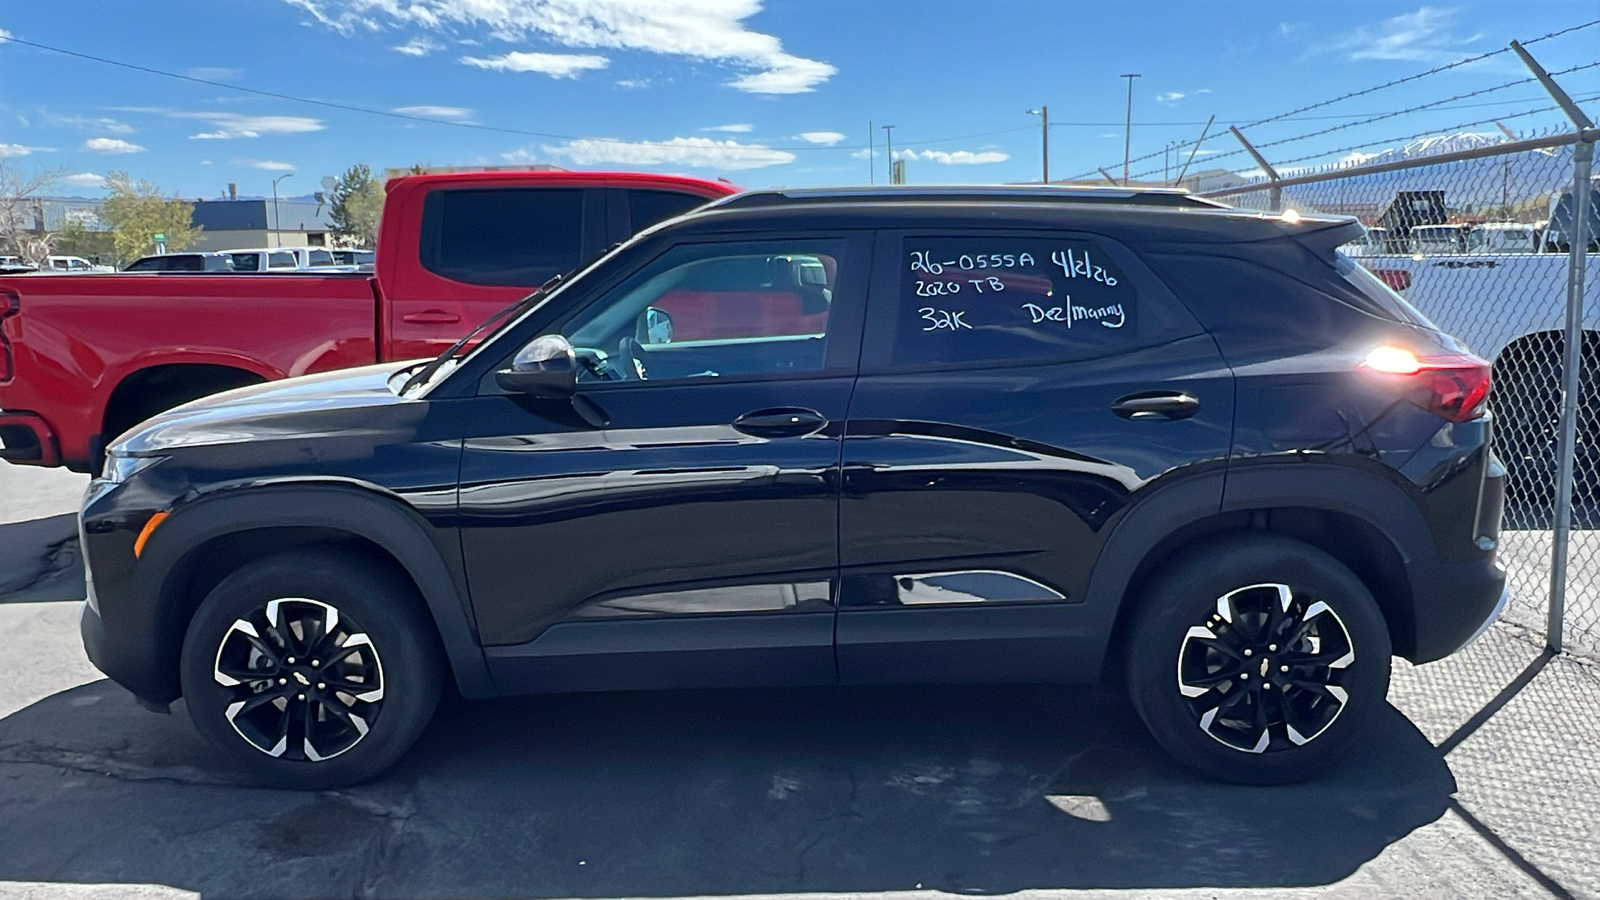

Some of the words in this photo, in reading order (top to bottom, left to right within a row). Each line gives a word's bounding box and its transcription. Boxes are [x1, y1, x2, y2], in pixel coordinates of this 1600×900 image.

[910, 251, 1035, 274] 26-0555A
[1052, 249, 1117, 286] 4/2/26
[916, 281, 960, 296] 2020
[968, 277, 1004, 293] TB
[918, 307, 973, 331] 32K
